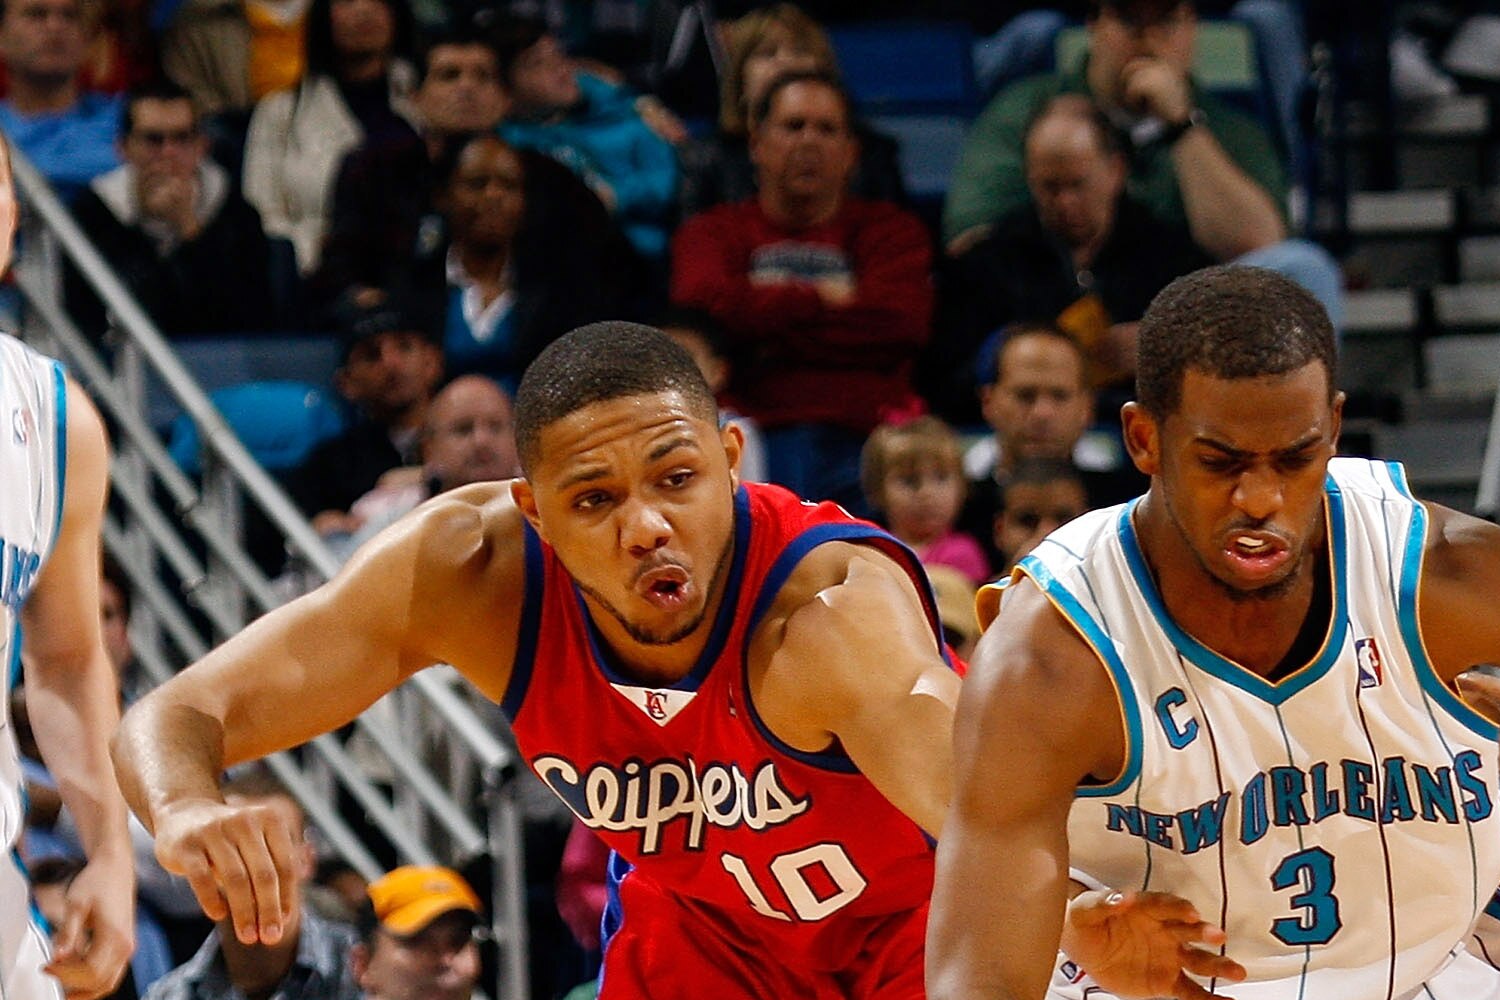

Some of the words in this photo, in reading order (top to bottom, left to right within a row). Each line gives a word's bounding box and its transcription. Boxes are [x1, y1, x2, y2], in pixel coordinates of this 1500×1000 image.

[1154, 686, 1199, 750] C
[531, 755, 811, 854] Clippers
[1103, 791, 1231, 855] NEW
[1240, 749, 1493, 846] ORLEANS
[720, 842, 868, 922] 10
[1270, 845, 1343, 946] 3
